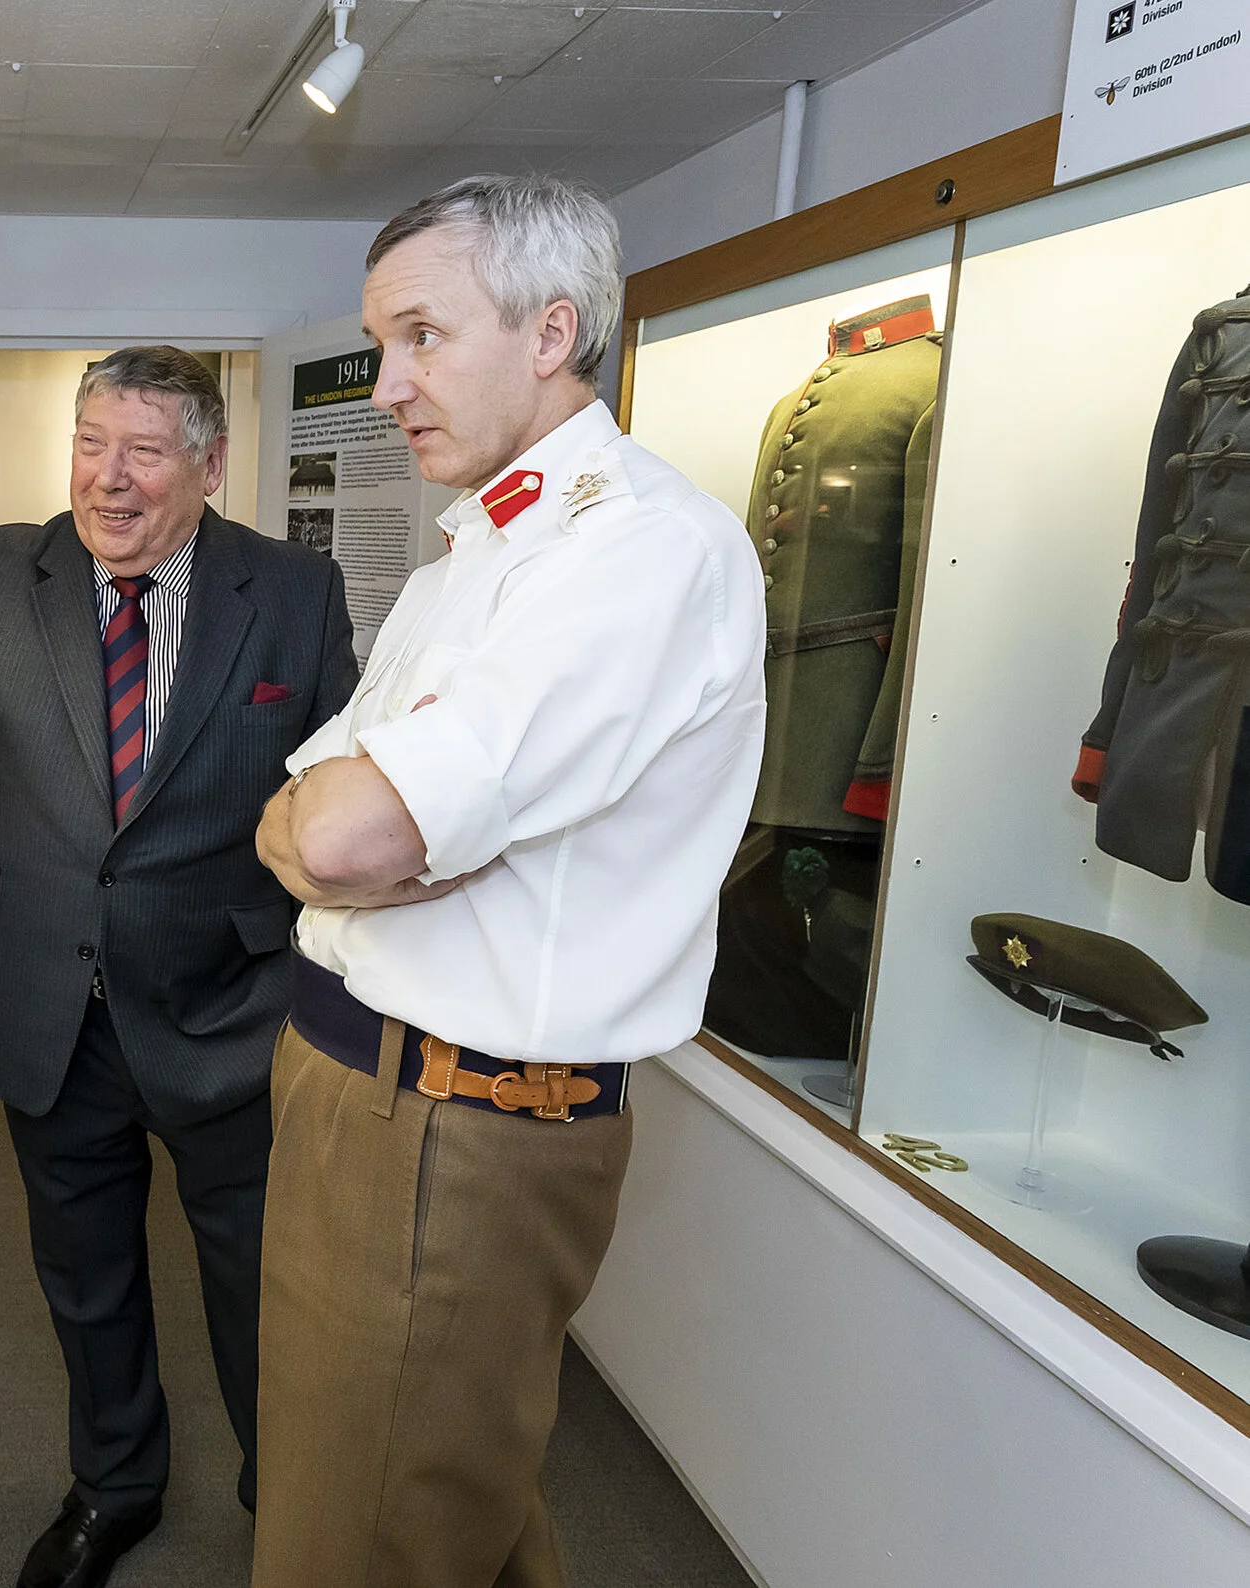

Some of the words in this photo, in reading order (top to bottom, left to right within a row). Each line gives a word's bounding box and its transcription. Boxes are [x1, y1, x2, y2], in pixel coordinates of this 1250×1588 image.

[1142, 1, 1182, 25] Division
[1134, 63, 1157, 80] 60th
[1160, 48, 1194, 73] (2/2nd
[1196, 30, 1241, 57] London)
[1133, 75, 1173, 97] Division
[337, 357, 369, 385] 1914
[304, 395, 316, 405] THE
[317, 390, 342, 403] LONDON
